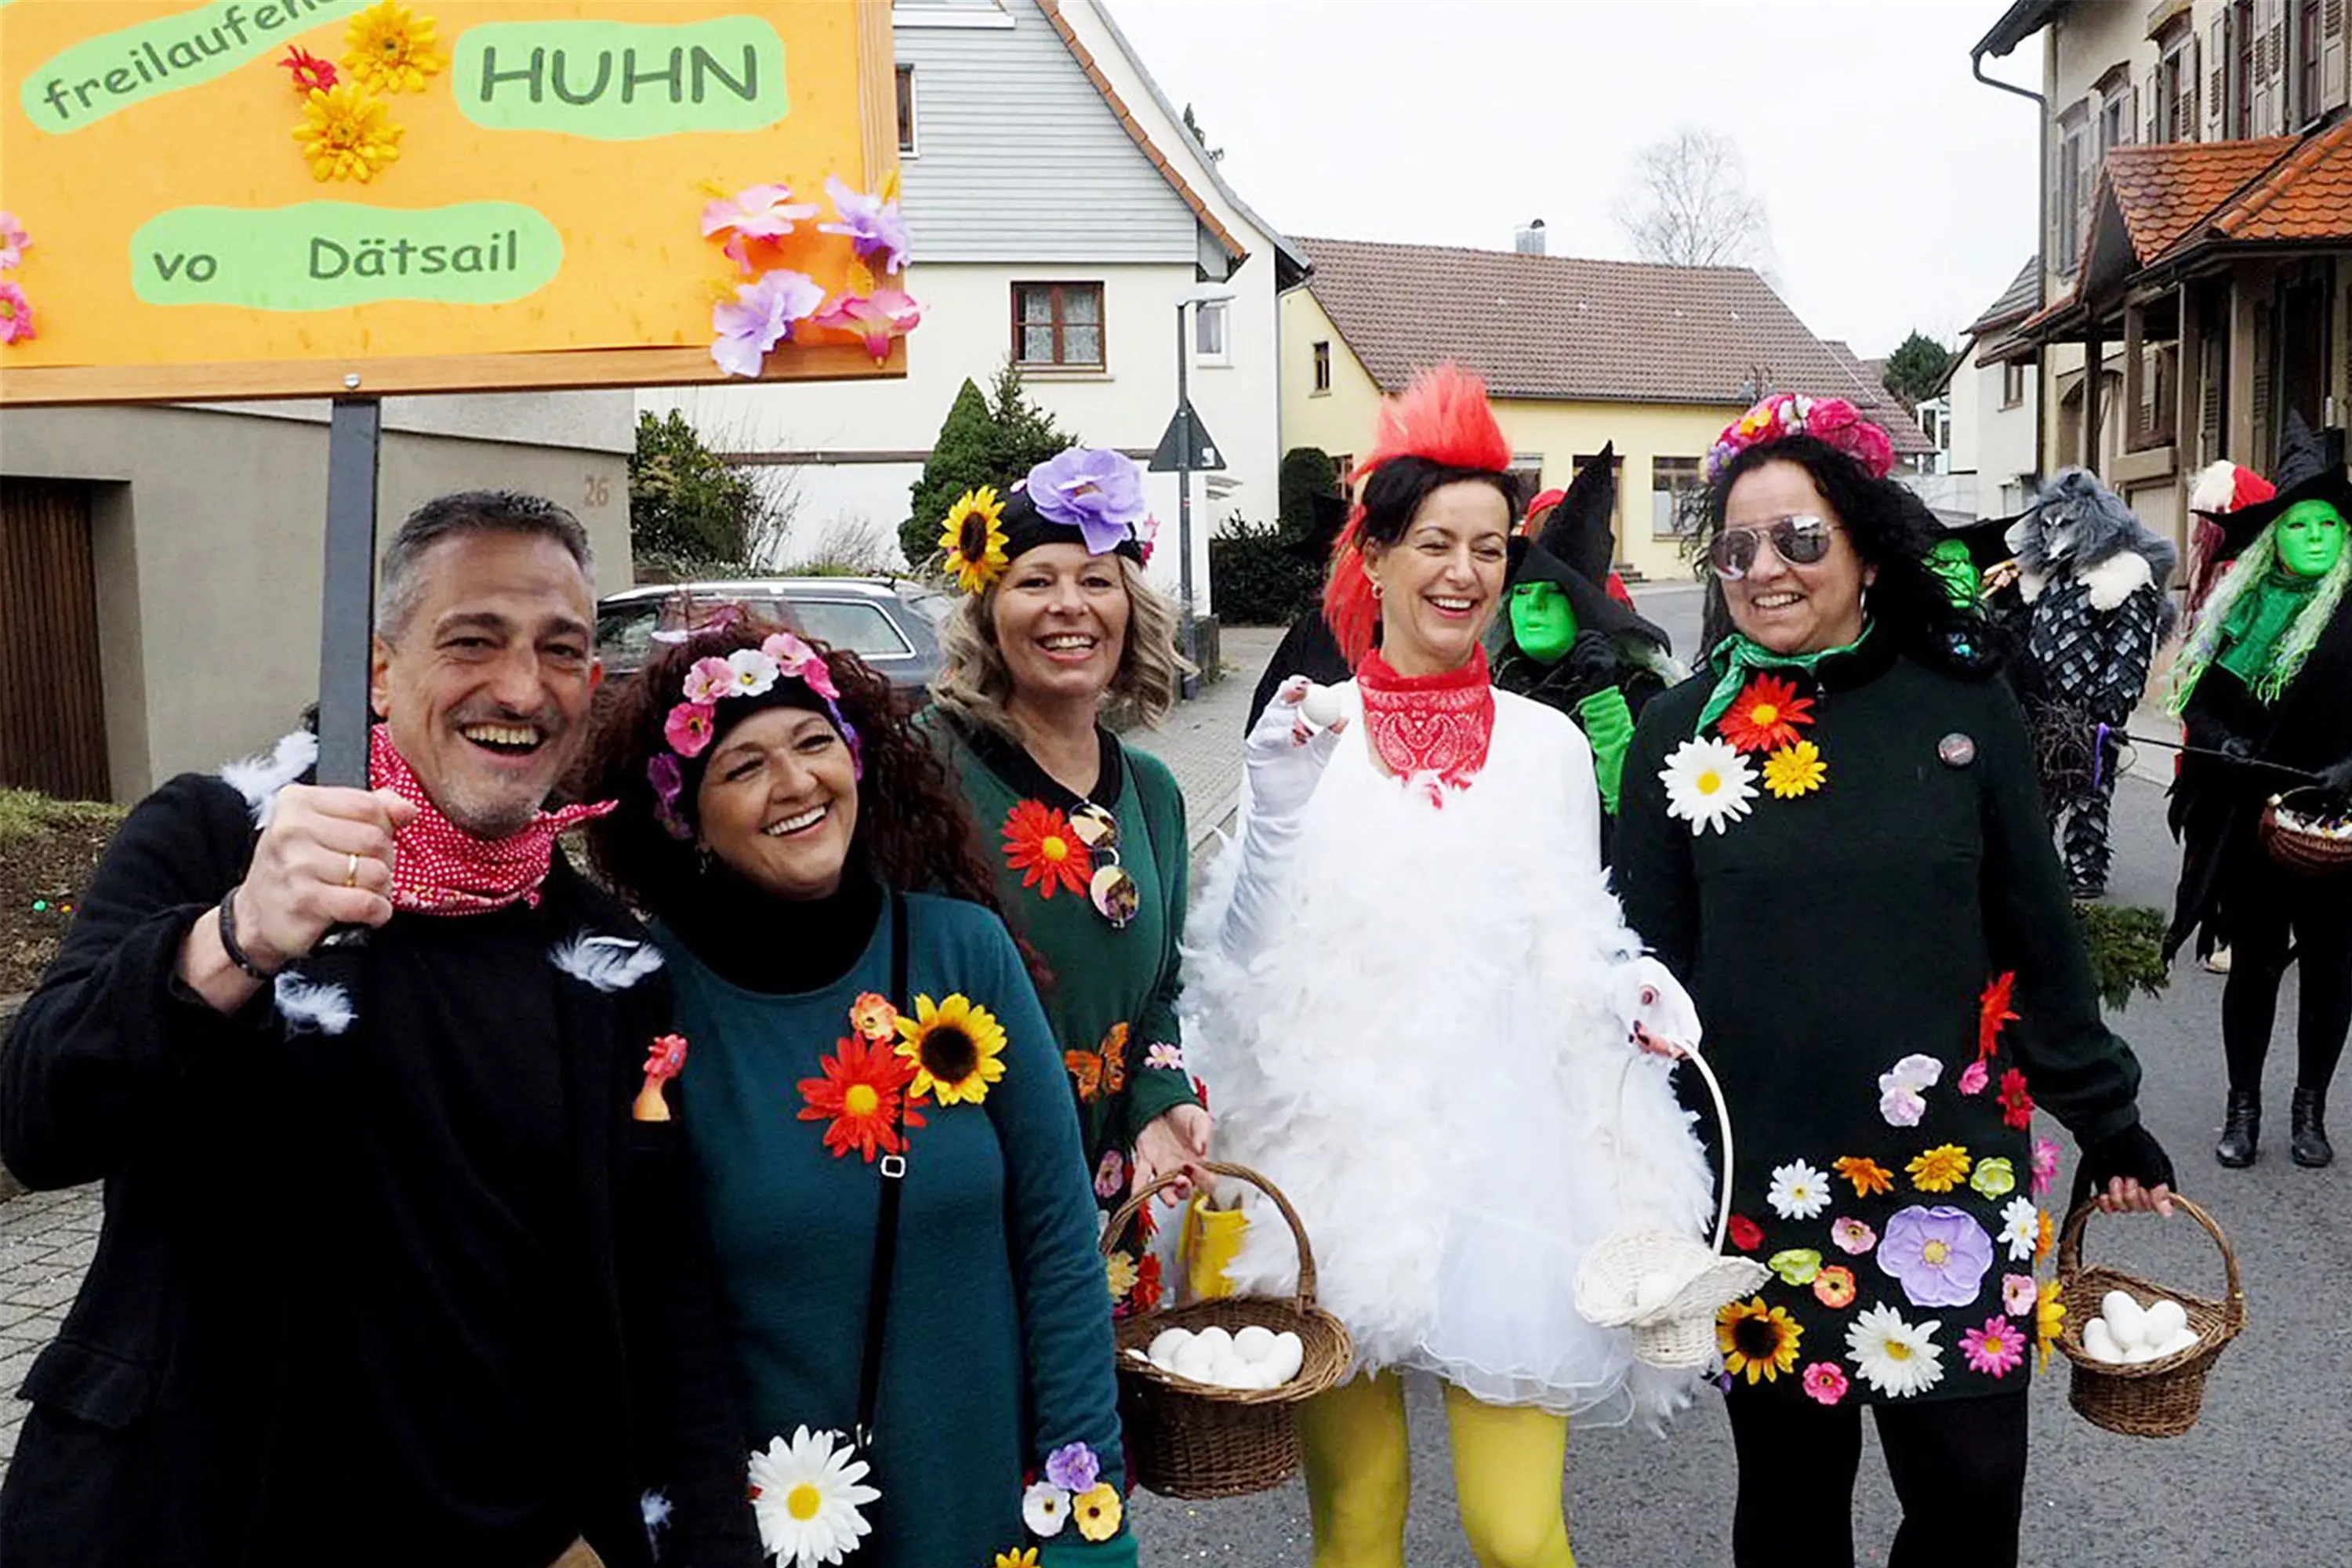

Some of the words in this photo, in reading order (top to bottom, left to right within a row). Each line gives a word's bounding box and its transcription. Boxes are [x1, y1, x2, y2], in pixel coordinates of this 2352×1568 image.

[479, 44, 757, 105] HUHN
[153, 252, 218, 283] vo
[310, 230, 517, 280] Dätsail
[584, 476, 610, 507] 26
